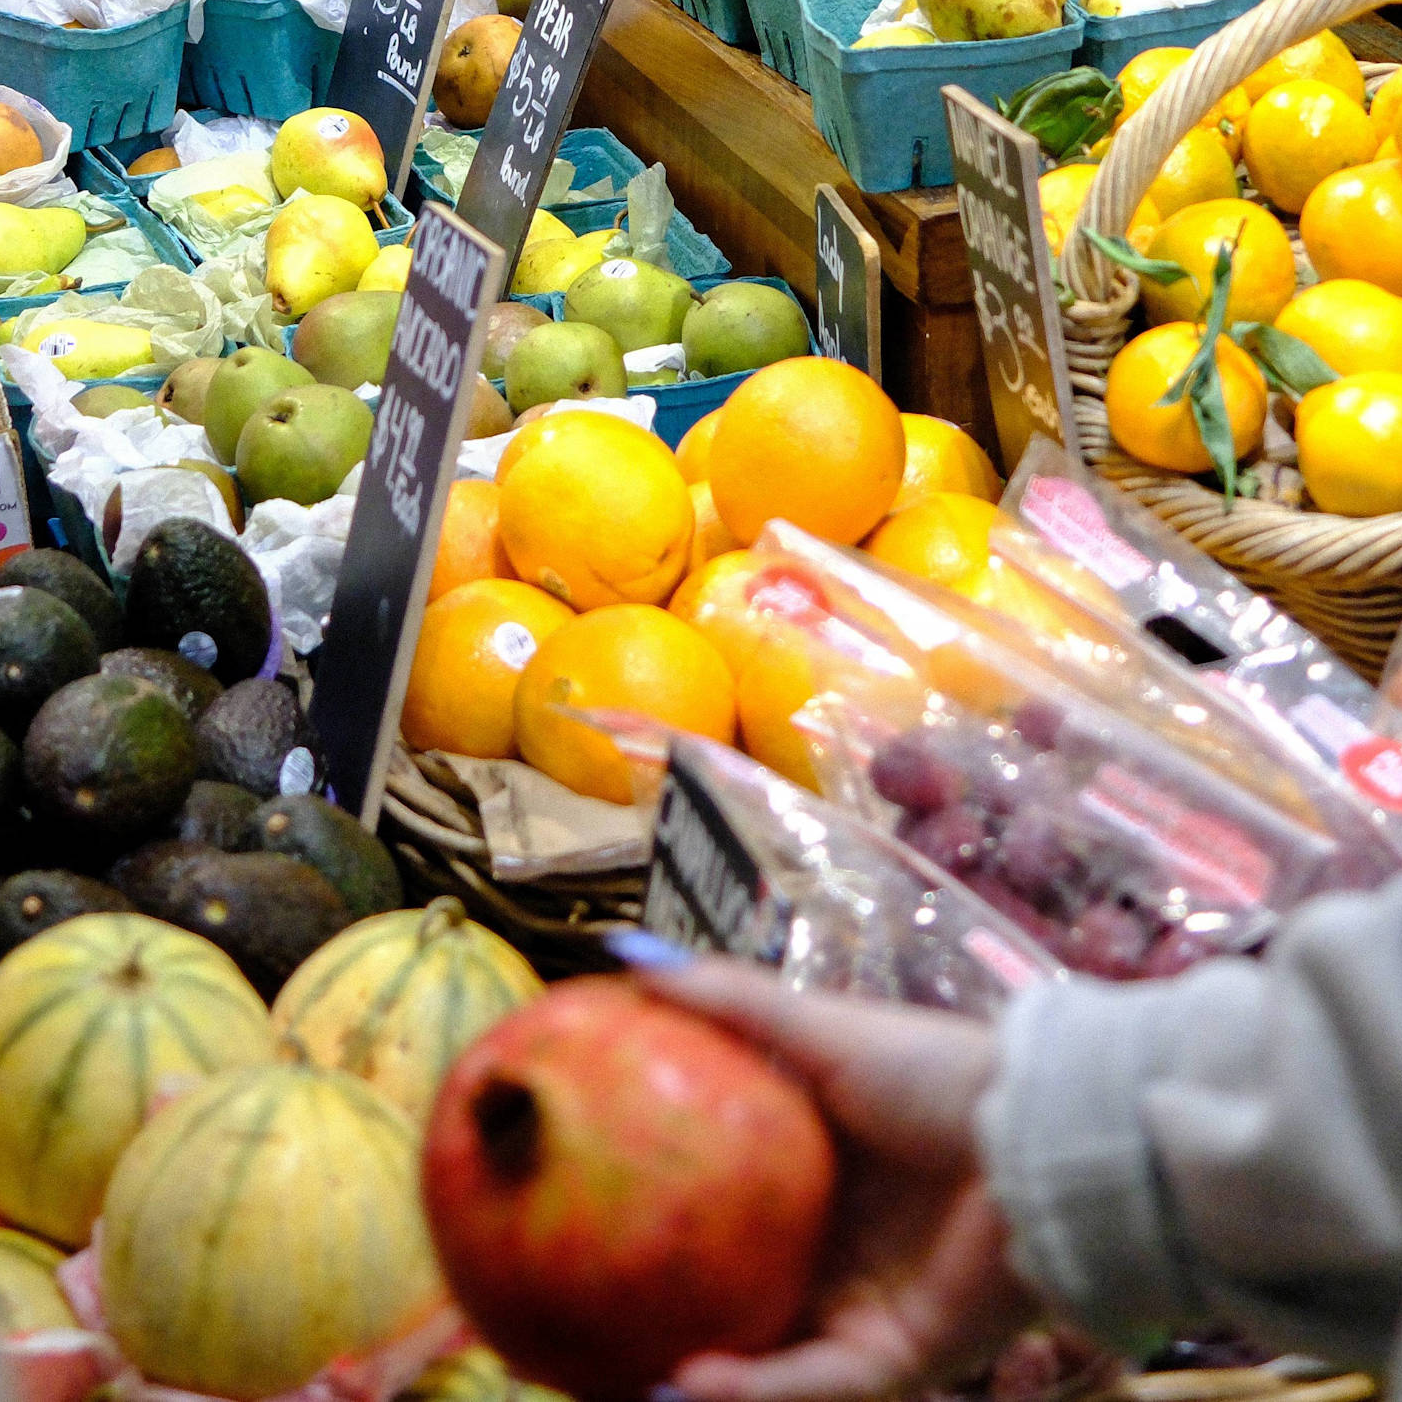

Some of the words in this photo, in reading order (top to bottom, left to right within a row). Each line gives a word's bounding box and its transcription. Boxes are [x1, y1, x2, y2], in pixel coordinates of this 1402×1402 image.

[386, 33, 423, 87] Pound
[413, 210, 487, 322] ORGANIC
[817, 205, 845, 314] Lady
